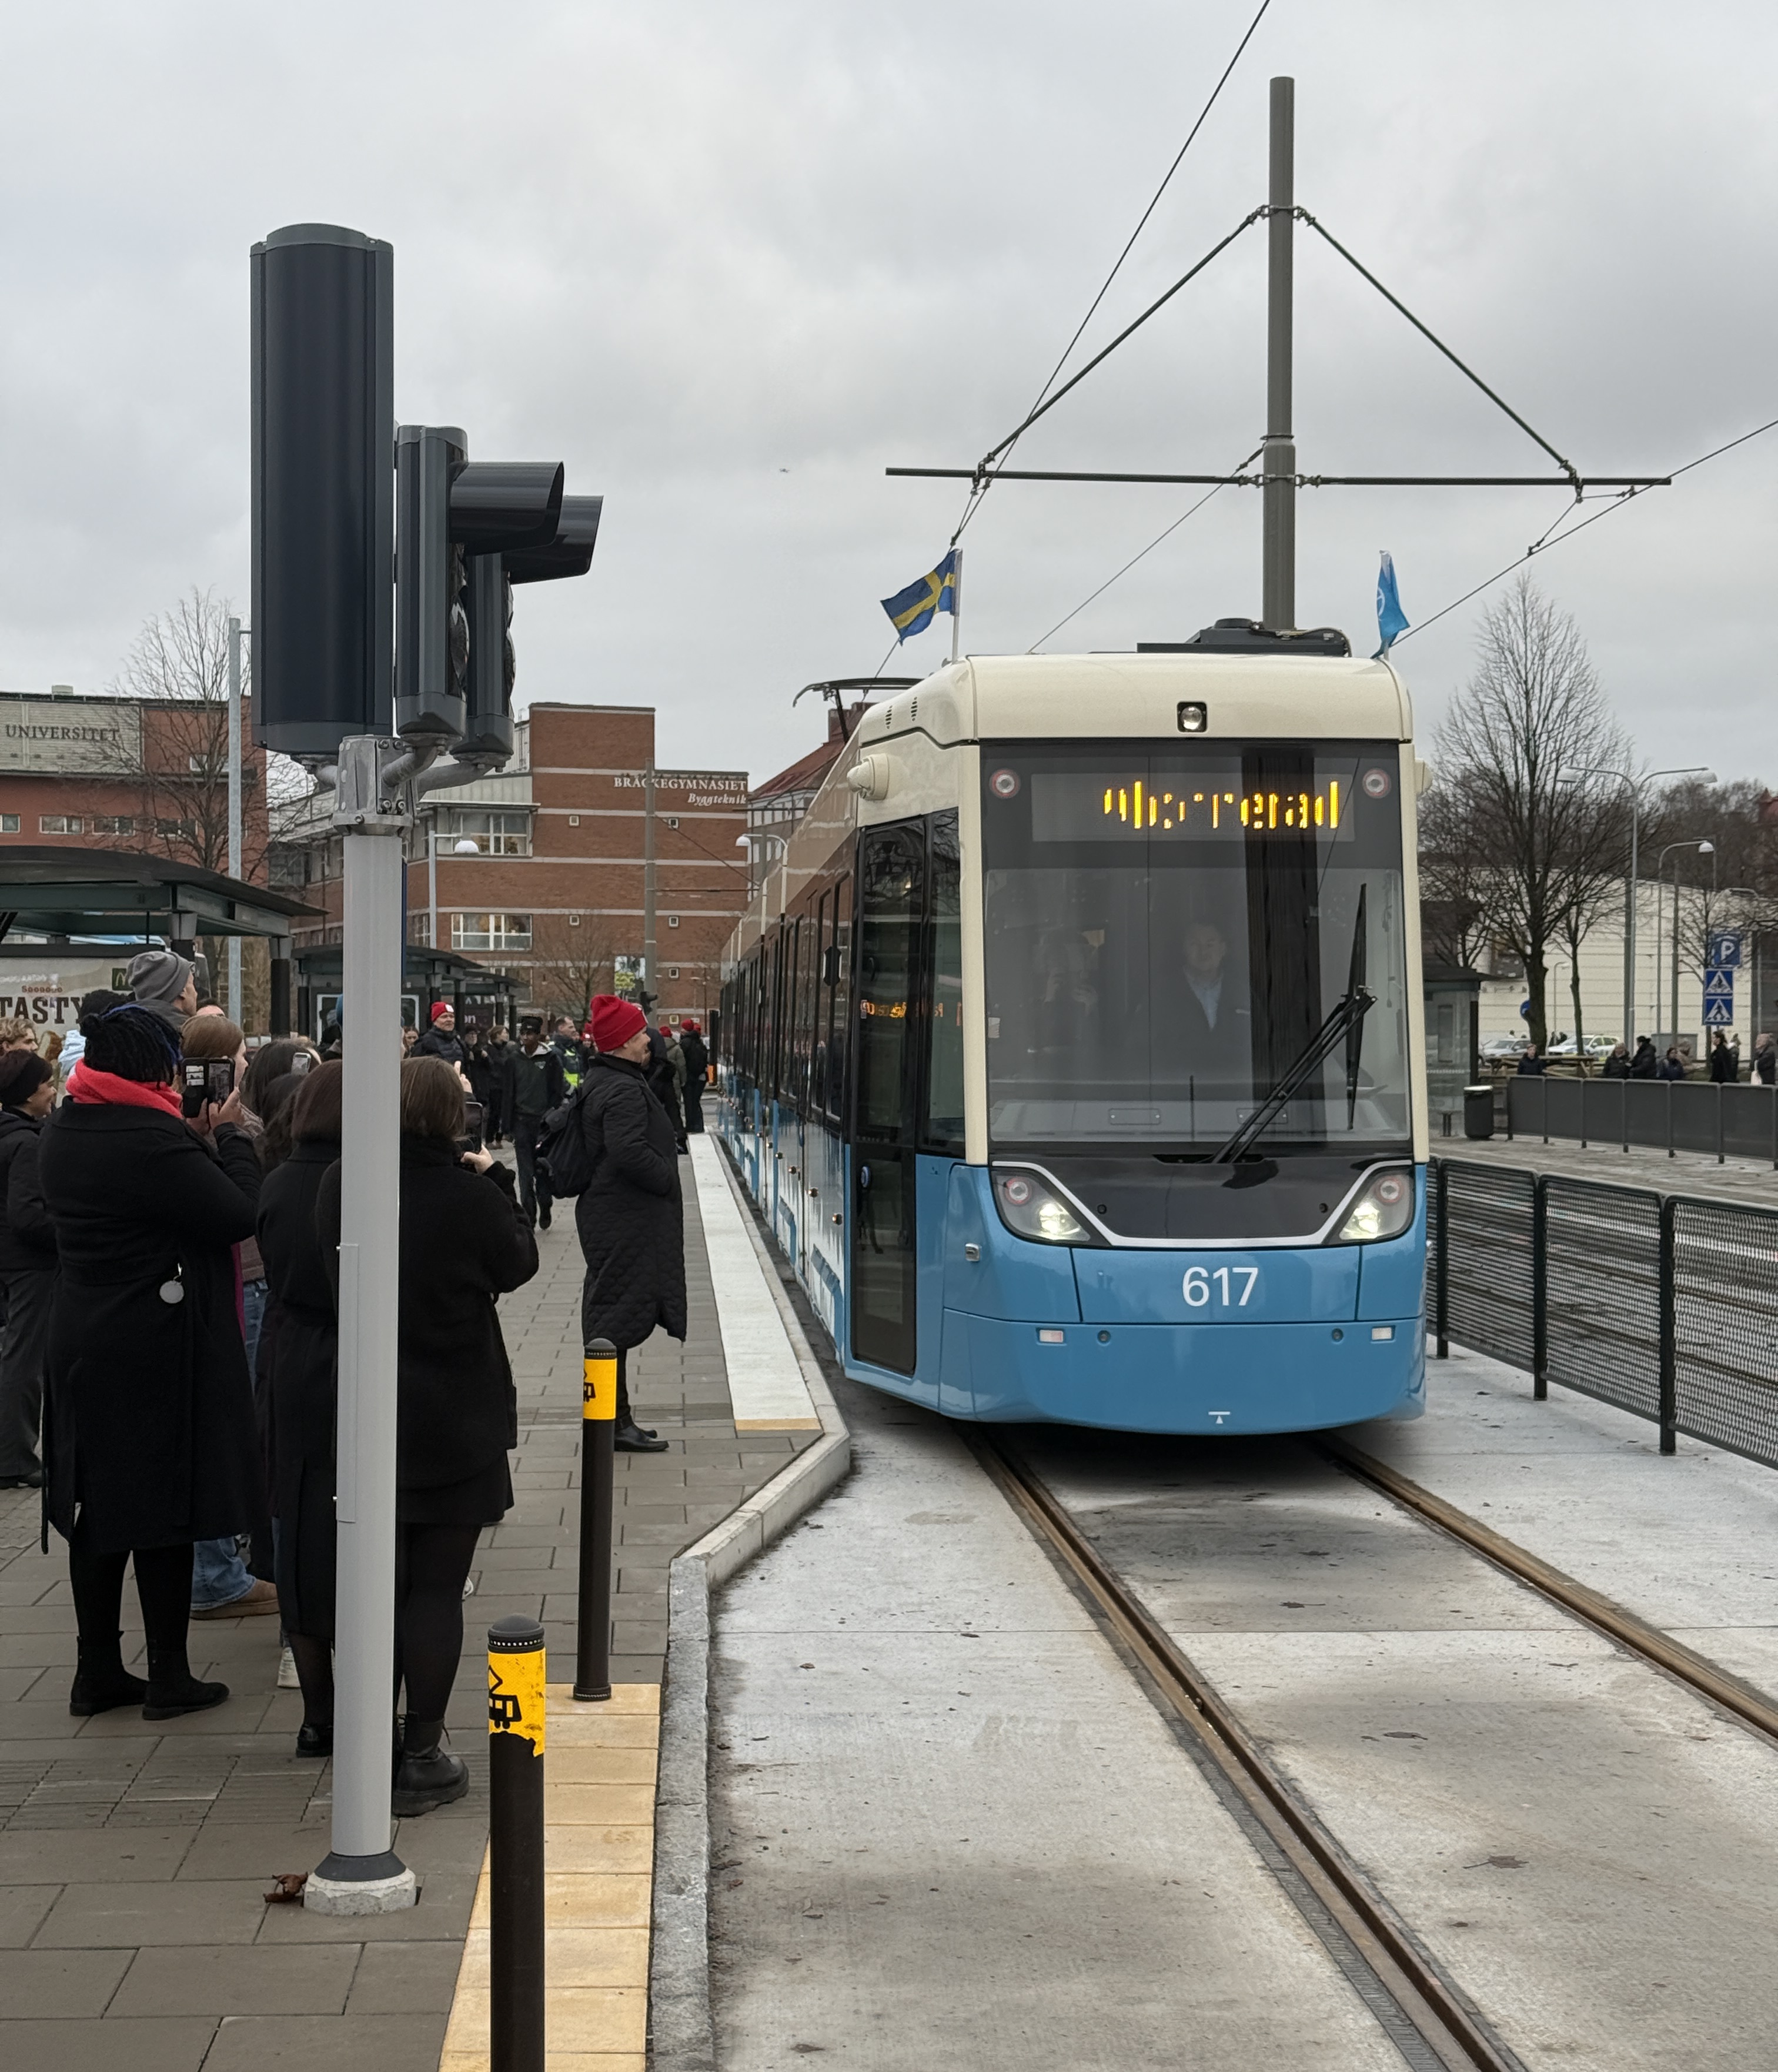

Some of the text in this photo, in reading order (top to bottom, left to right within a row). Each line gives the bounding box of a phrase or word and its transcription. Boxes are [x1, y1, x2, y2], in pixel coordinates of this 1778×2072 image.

[5, 724, 120, 741] UNIVERSITET
[687, 793, 747, 807] Byggteknik
[1721, 941, 1735, 963] P
[0, 997, 85, 1024] TASTY
[1182, 1266, 1258, 1306] 617
